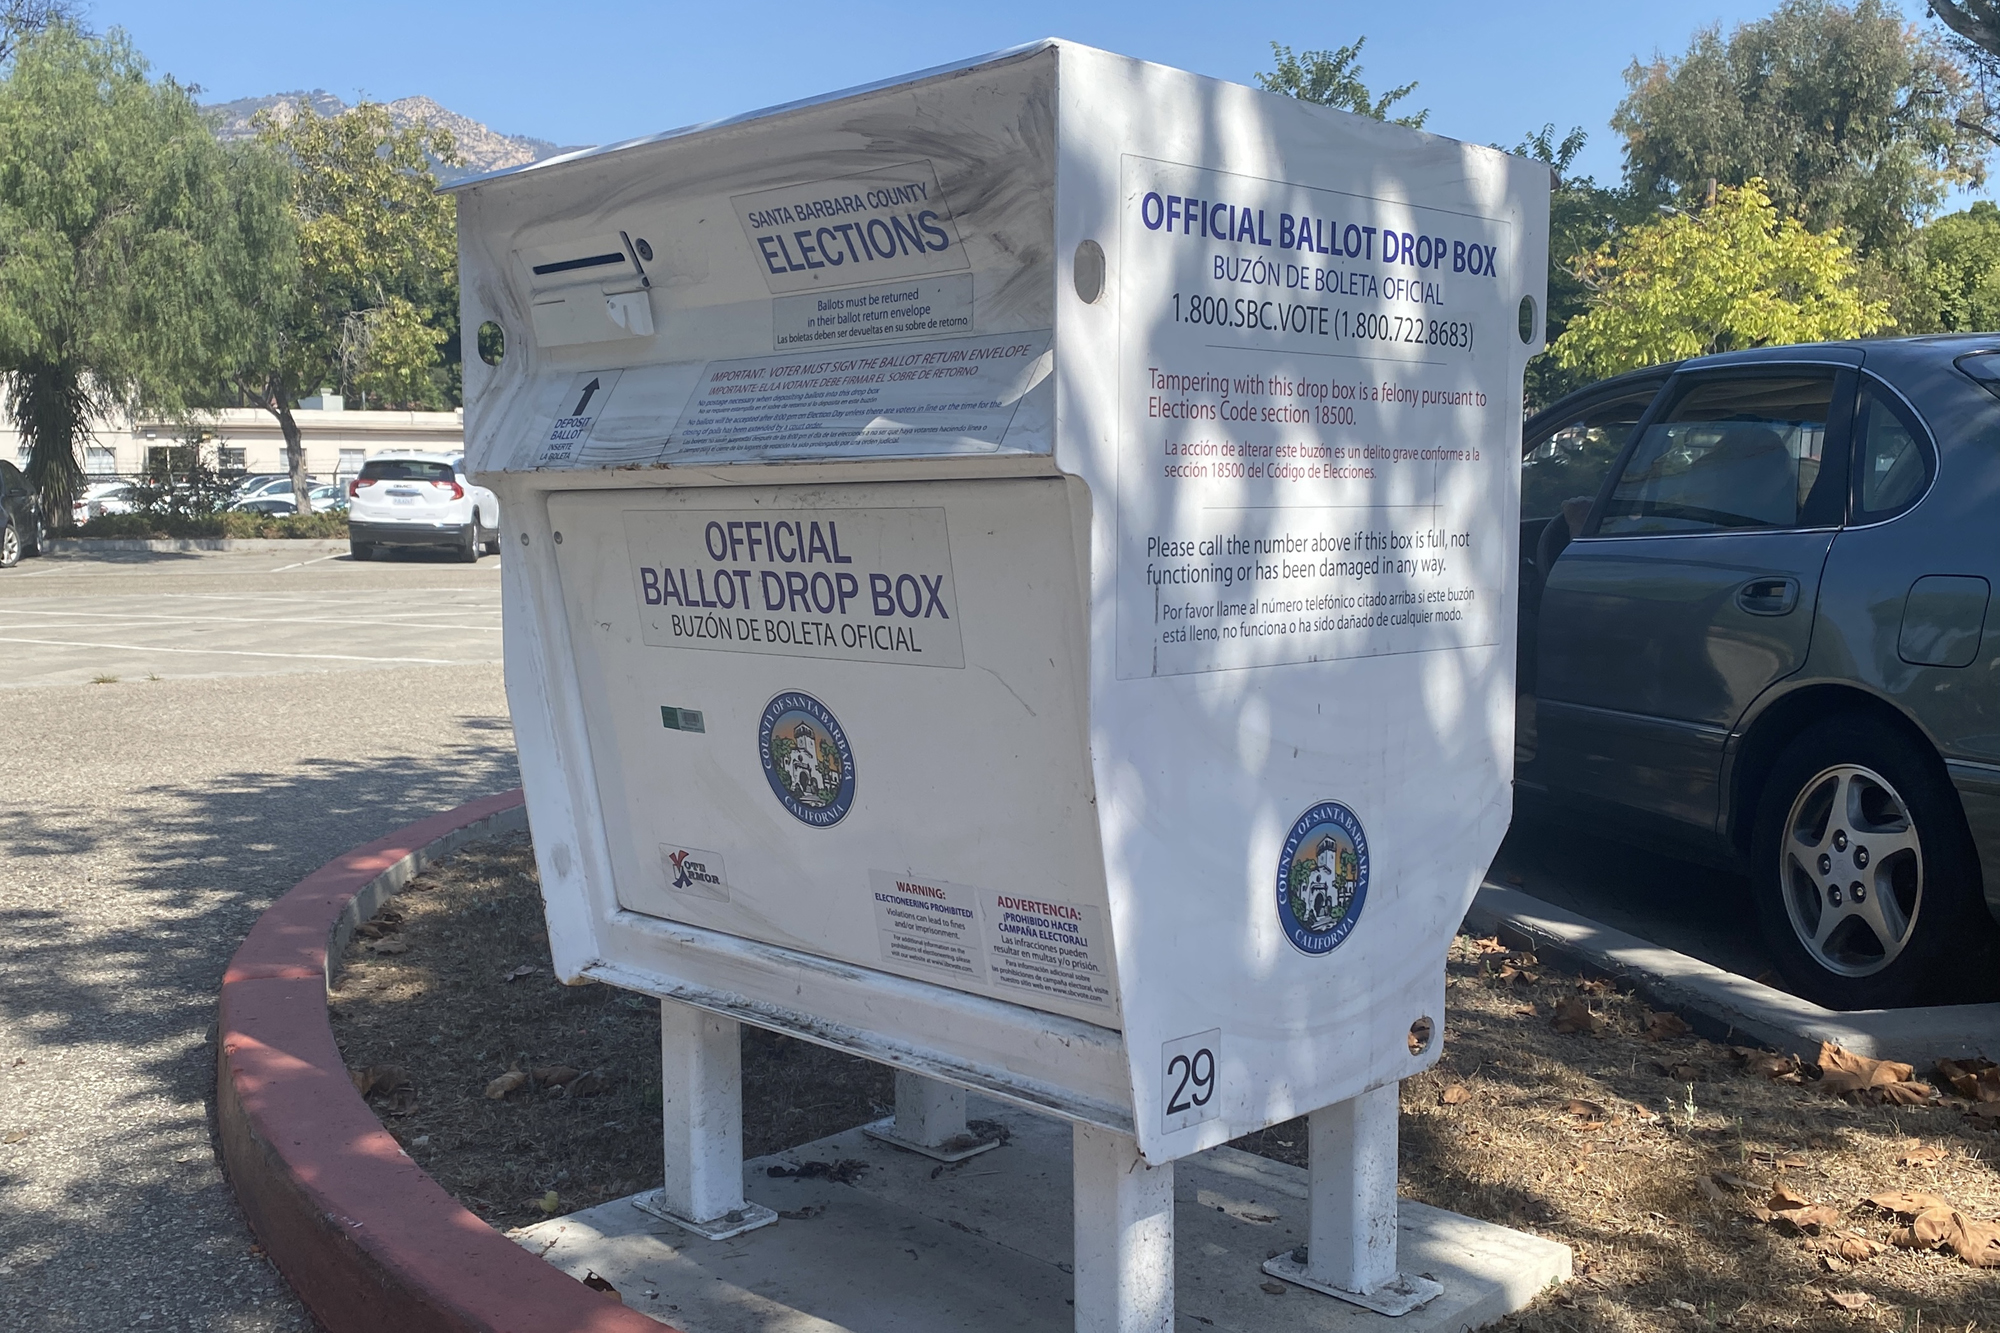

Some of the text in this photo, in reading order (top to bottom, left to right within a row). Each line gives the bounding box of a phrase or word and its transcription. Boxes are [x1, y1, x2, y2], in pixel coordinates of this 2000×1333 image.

[748, 182, 928, 229] SANTA BARBARA COUNTY
[757, 210, 949, 274] ELECTIONS
[1141, 191, 1497, 278] OFFICIAL BALLOT DROP BOX
[1214, 255, 1444, 306] BUZÓN DE BOLETA OFICIAL
[817, 288, 919, 312] Ballots must be returned
[807, 304, 931, 328] in their ballot return envelope
[1172, 292, 1474, 352] 1.800.SBC.VOTE (1.800.722.8683)
[777, 317, 968, 345] Las boletas deben ser devueltas en su sobre de retorno
[710, 344, 1031, 382] IMPORTANT: VOTER MUST SIGN THE BALLOT RETURN ENVELOPE
[758, 381, 782, 392] EL/LA
[782, 379, 820, 390] VOTANTE
[819, 377, 841, 387] DEBE
[841, 373, 875, 386] FIRMAR
[875, 374, 886, 383] EL
[887, 371, 919, 382] SOBRE
[918, 369, 933, 380] DE
[934, 366, 978, 378] RETORNO
[1148, 367, 1487, 409] Tampering with this drop box is a felony pursuant to
[554, 417, 592, 429] DEPOSIT
[1149, 396, 1357, 426] Elections Code section 18500.
[550, 429, 583, 440] BALLOT
[548, 452, 571, 460] BOLETA
[1164, 439, 1480, 464] La acción de alterar este buzón es un delito grave conforme a la
[1164, 462, 1377, 482] sección 18500 del Código de Elecciones.
[705, 521, 852, 564] OFFICIAL
[1147, 529, 1470, 558] Please call the number above if this box is full, not
[1146, 555, 1447, 587] functioning or has been damaged in any way.
[640, 567, 950, 620] BALLOT DROP BOX
[671, 612, 922, 652] BUZÓN DE BOLETA OFICIAL
[761, 697, 853, 780] COUNTY OF SANTA BARBARA
[784, 795, 844, 823] CALIFORNIA
[1279, 807, 1367, 905] COUNTY OF SANTA BARBARA
[896, 881, 946, 900] WARNING:
[875, 892, 974, 919] ELECTIONEERING PROHIBITED!
[886, 907, 966, 930] Violations can lead to fines
[997, 895, 1082, 921] ADVERTENCIA:
[894, 920, 960, 940] and/or imprisonment.
[998, 922, 1088, 947] CAMPAÑA ELECTORAL!
[1003, 912, 1079, 934] ¡PROHIBIDO HACER
[1295, 917, 1354, 950] CALIFORNIA
[993, 945, 1100, 973] resultar en multas y/o prisión.
[1001, 935, 1088, 959] Las infracciones pueden
[1166, 1048, 1215, 1116] 29
